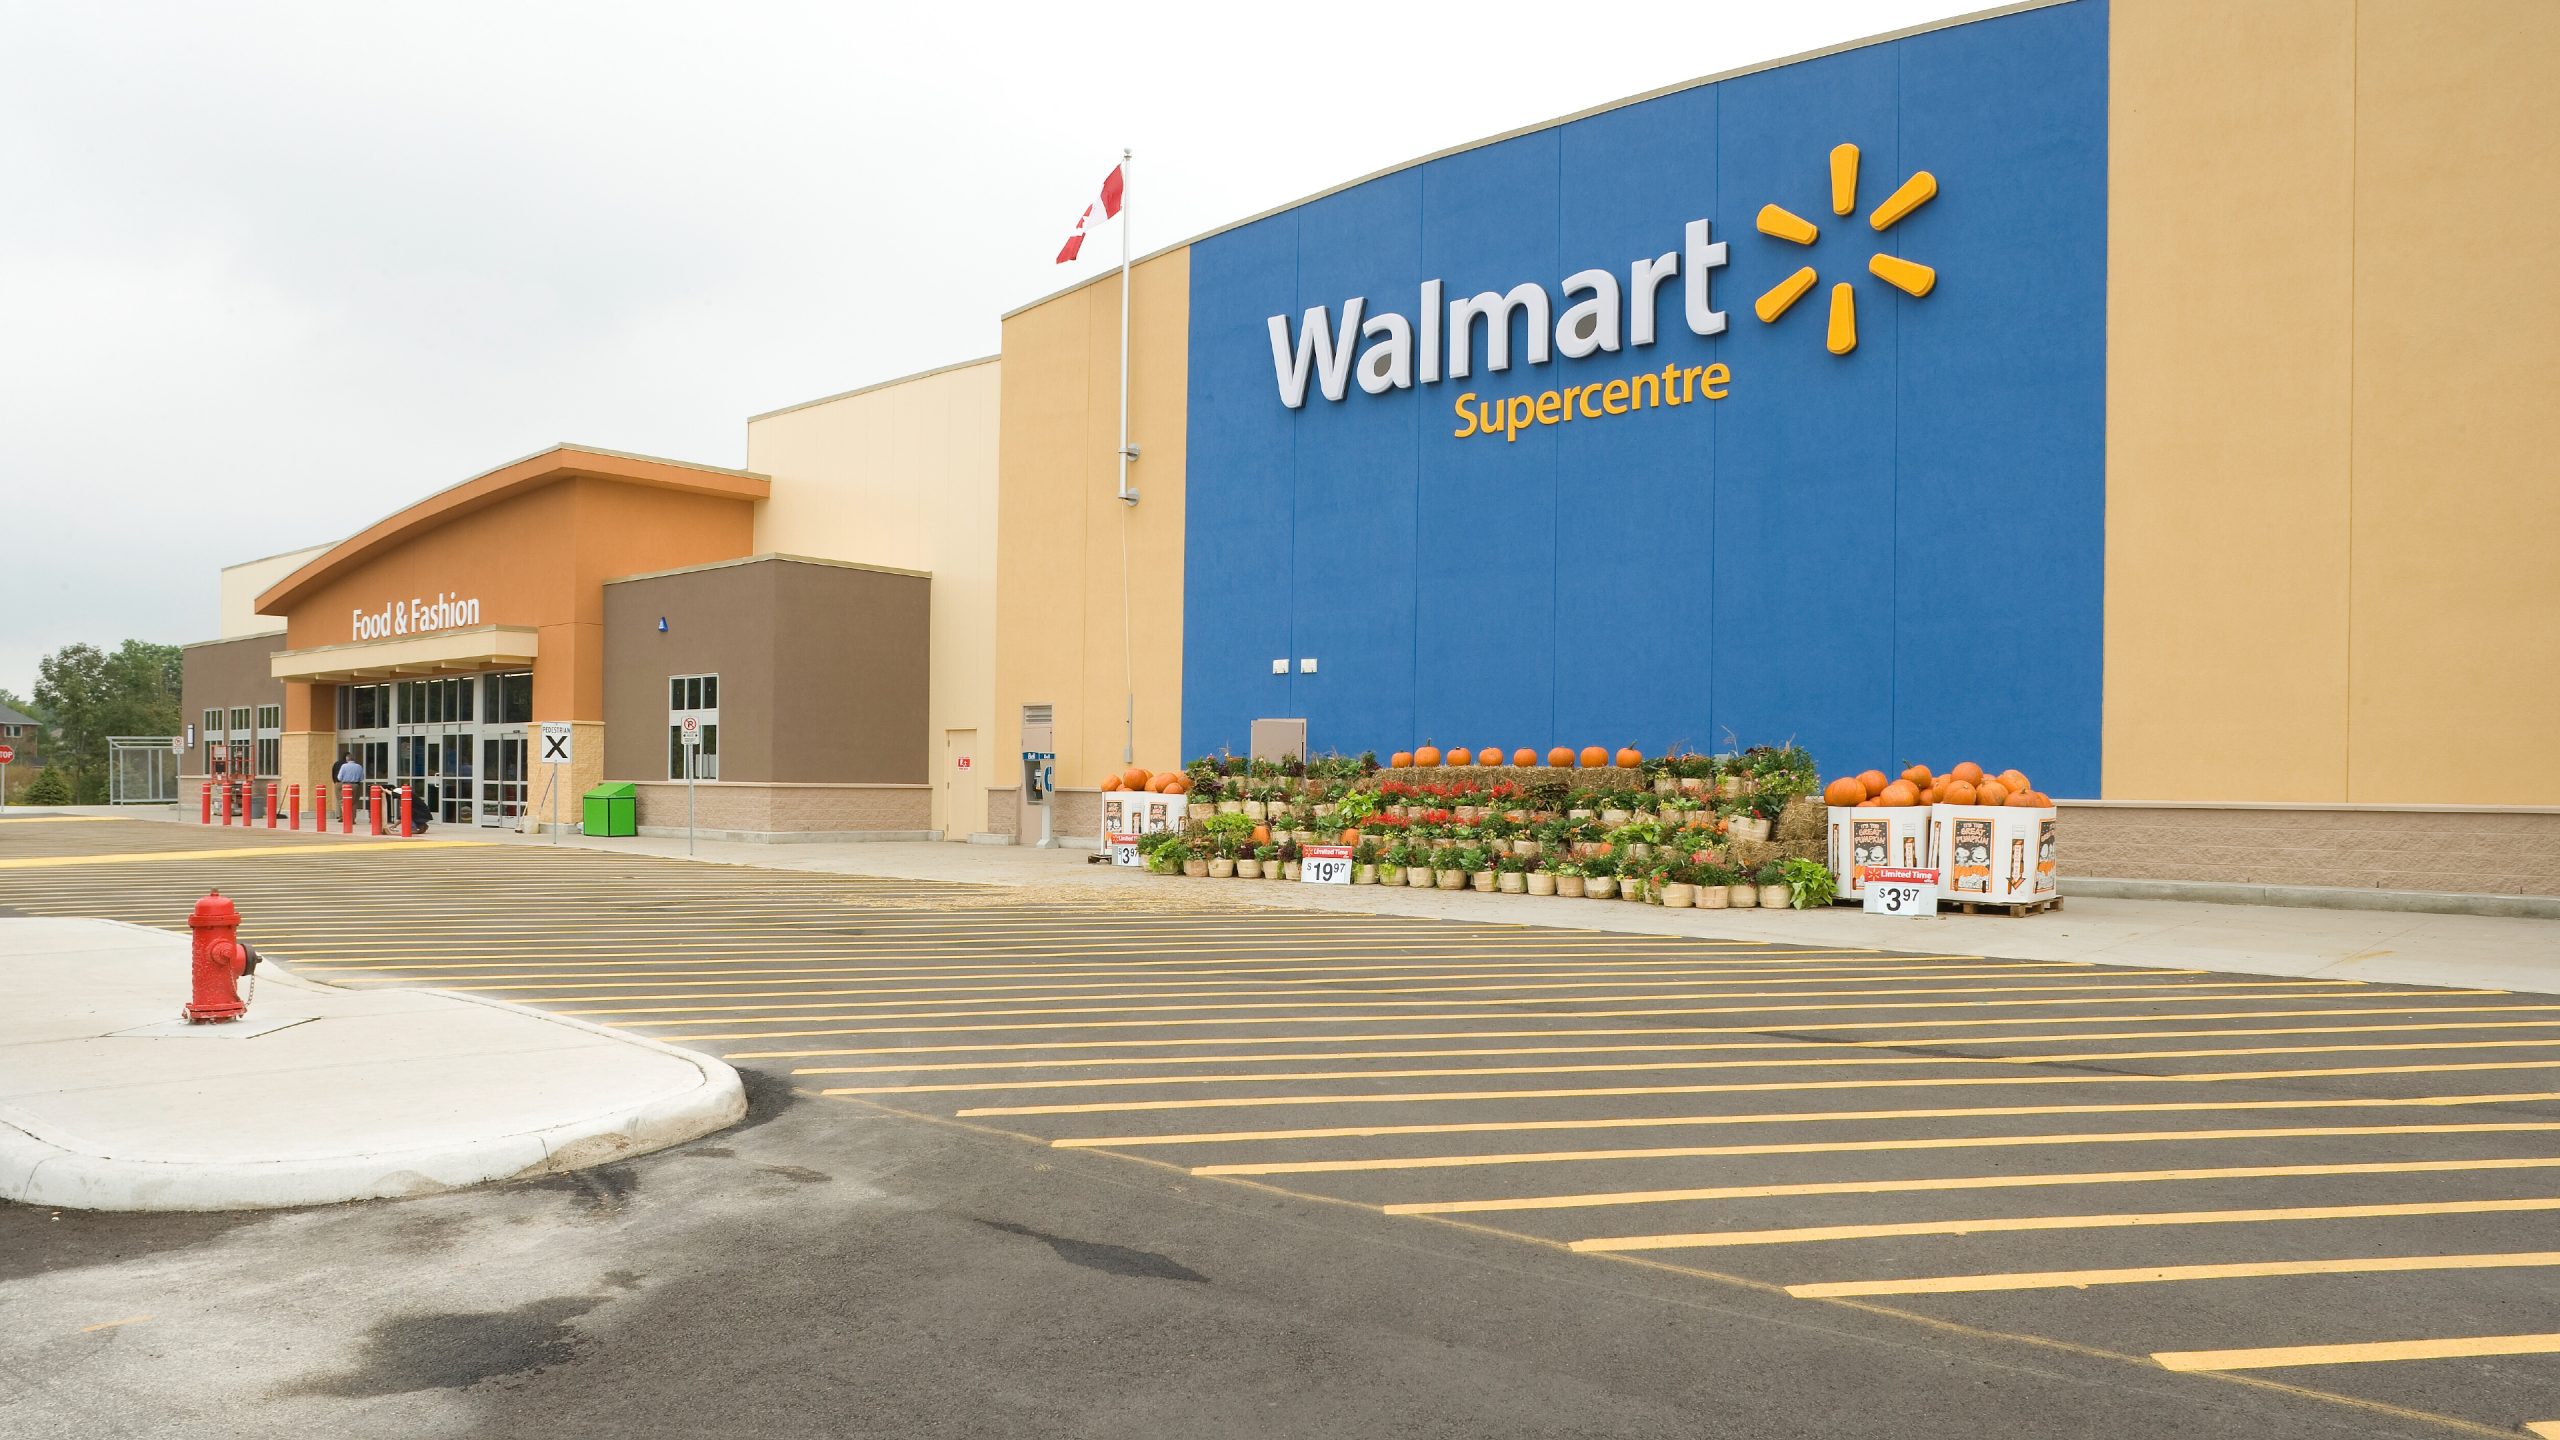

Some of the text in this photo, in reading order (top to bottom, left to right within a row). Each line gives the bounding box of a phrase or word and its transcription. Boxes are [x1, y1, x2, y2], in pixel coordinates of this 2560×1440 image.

[1267, 218, 1729, 409] Walmart
[1453, 362, 1731, 442] Supercentre
[352, 591, 480, 641] Food & Fashion
[0, 751, 13, 759] TOP
[1960, 827, 1986, 837] GREAT
[1854, 835, 1886, 845] PUMPKIN
[1955, 835, 1990, 845] PUMPKIN
[1334, 848, 1349, 856] Time
[1880, 870, 1932, 879] Limited Time
